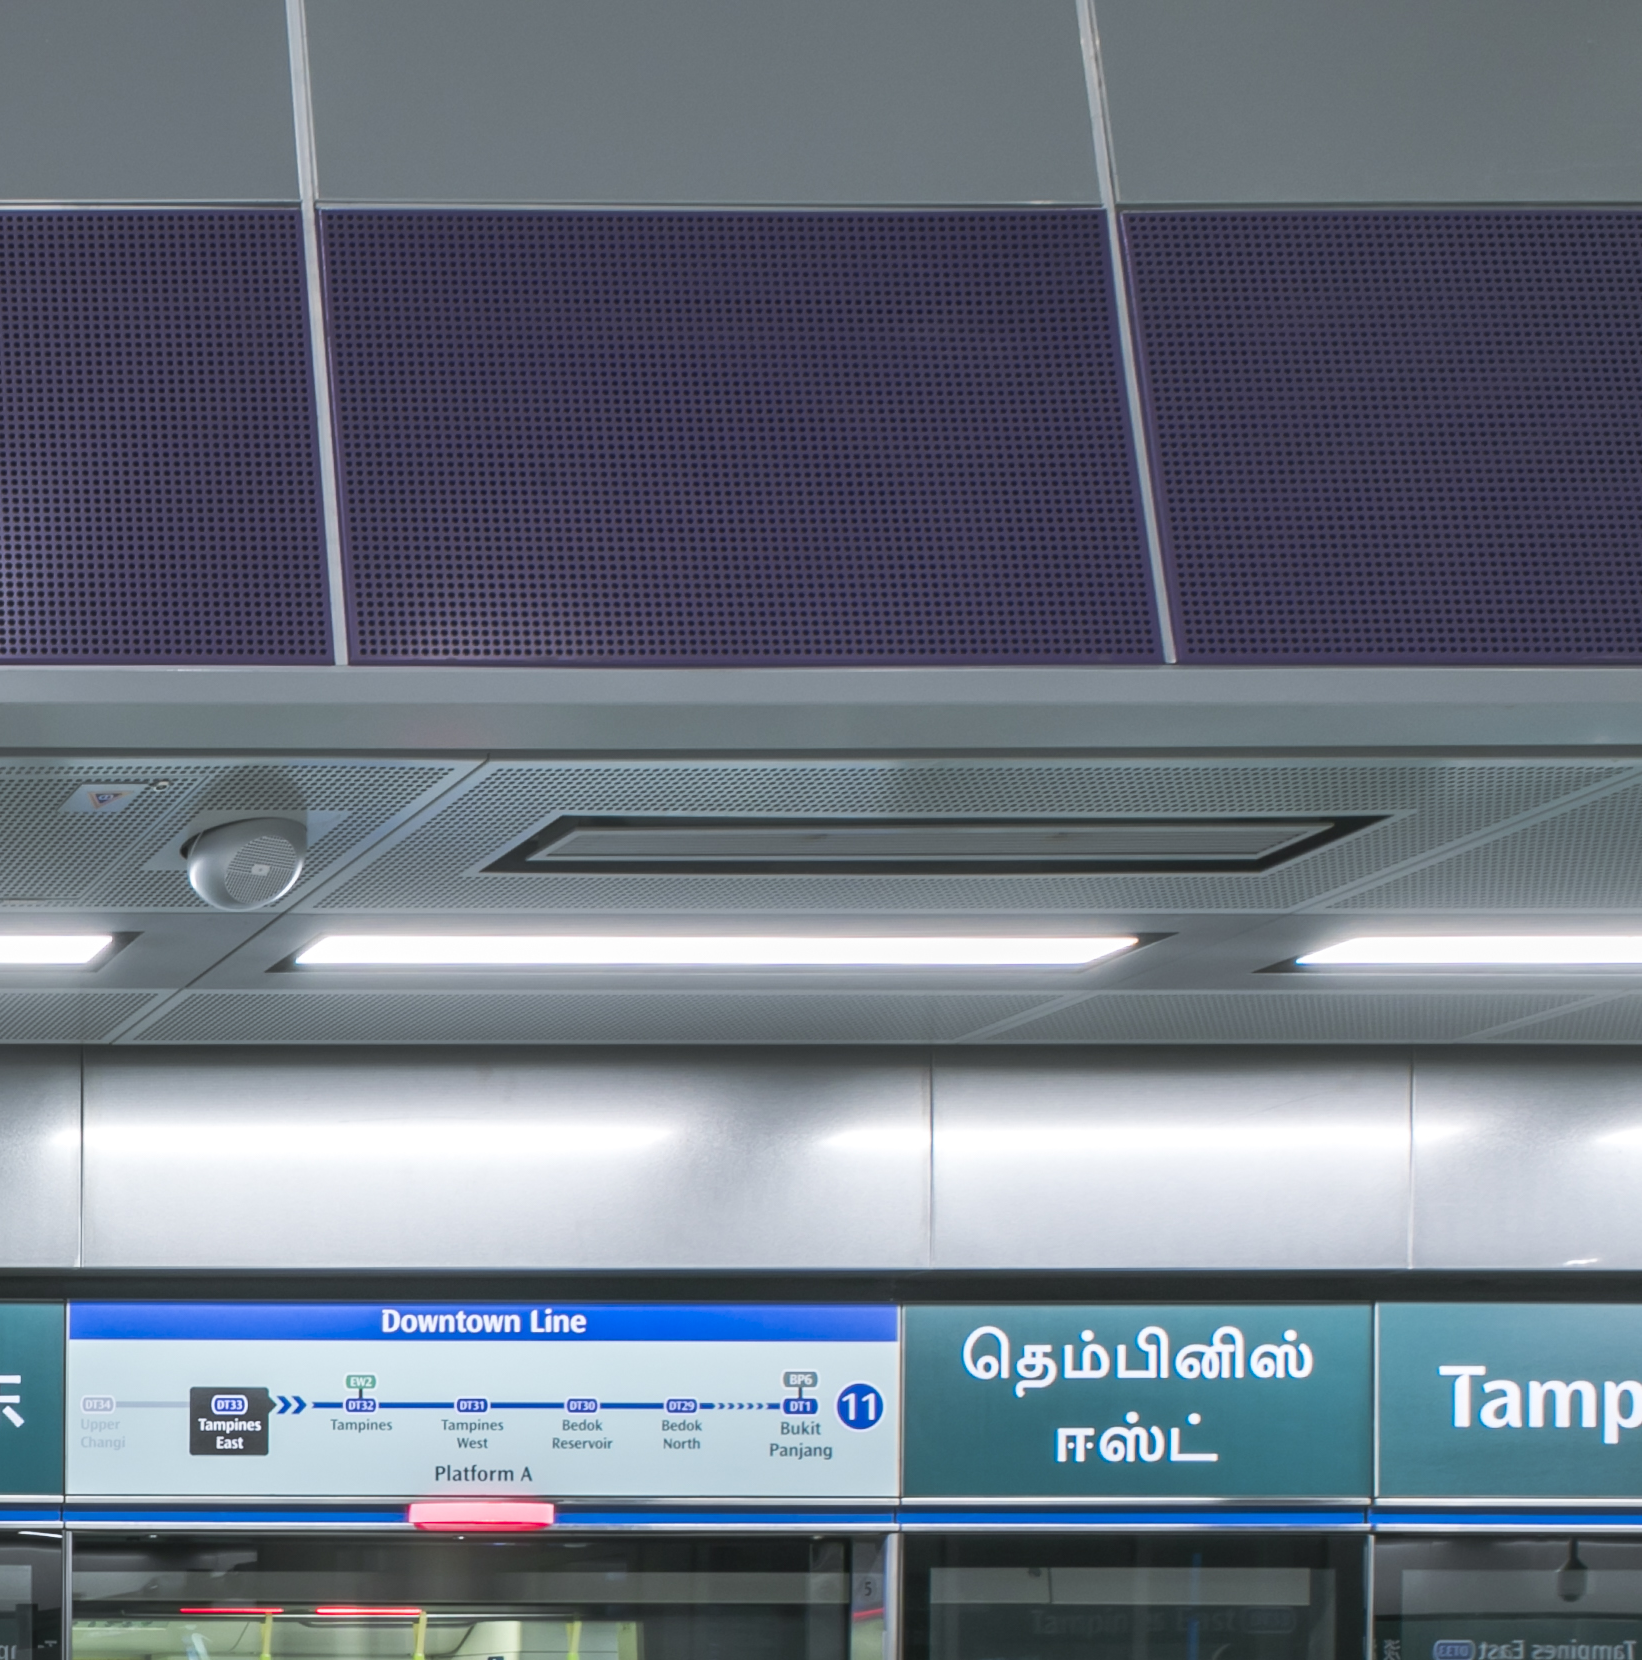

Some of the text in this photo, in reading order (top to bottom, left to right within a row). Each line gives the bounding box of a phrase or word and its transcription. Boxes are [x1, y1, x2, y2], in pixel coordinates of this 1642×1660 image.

[381, 1307, 587, 1334] Downtown Line
[963, 1325, 1314, 1398] தெம்பினிஸ்
[350, 1376, 373, 1387] EW2
[789, 1373, 813, 1386] BP6
[216, 1399, 243, 1410] DT33
[348, 1400, 374, 1411] DT32
[459, 1400, 485, 1411] DT31
[569, 1400, 596, 1411] DT30
[668, 1400, 695, 1411] DT29
[789, 1400, 811, 1412] DT1
[841, 1392, 878, 1421] 11
[1438, 1365, 1642, 1445] Tamp
[80, 1418, 121, 1433] Upper
[197, 1417, 262, 1434] Tampines
[330, 1418, 393, 1434] Tampines
[441, 1419, 504, 1434] Tampines
[562, 1419, 603, 1432] Bedok
[661, 1419, 702, 1432] Bedok
[780, 1421, 821, 1436] Bukit
[80, 1436, 126, 1451] Changi
[216, 1436, 244, 1450] East
[456, 1437, 488, 1449] West
[552, 1437, 613, 1450] Reservoir
[663, 1437, 701, 1450] North
[1057, 1411, 1219, 1463] ஈஸ்ட்
[769, 1442, 833, 1461] Panjang
[435, 1464, 533, 1482] Platform A
